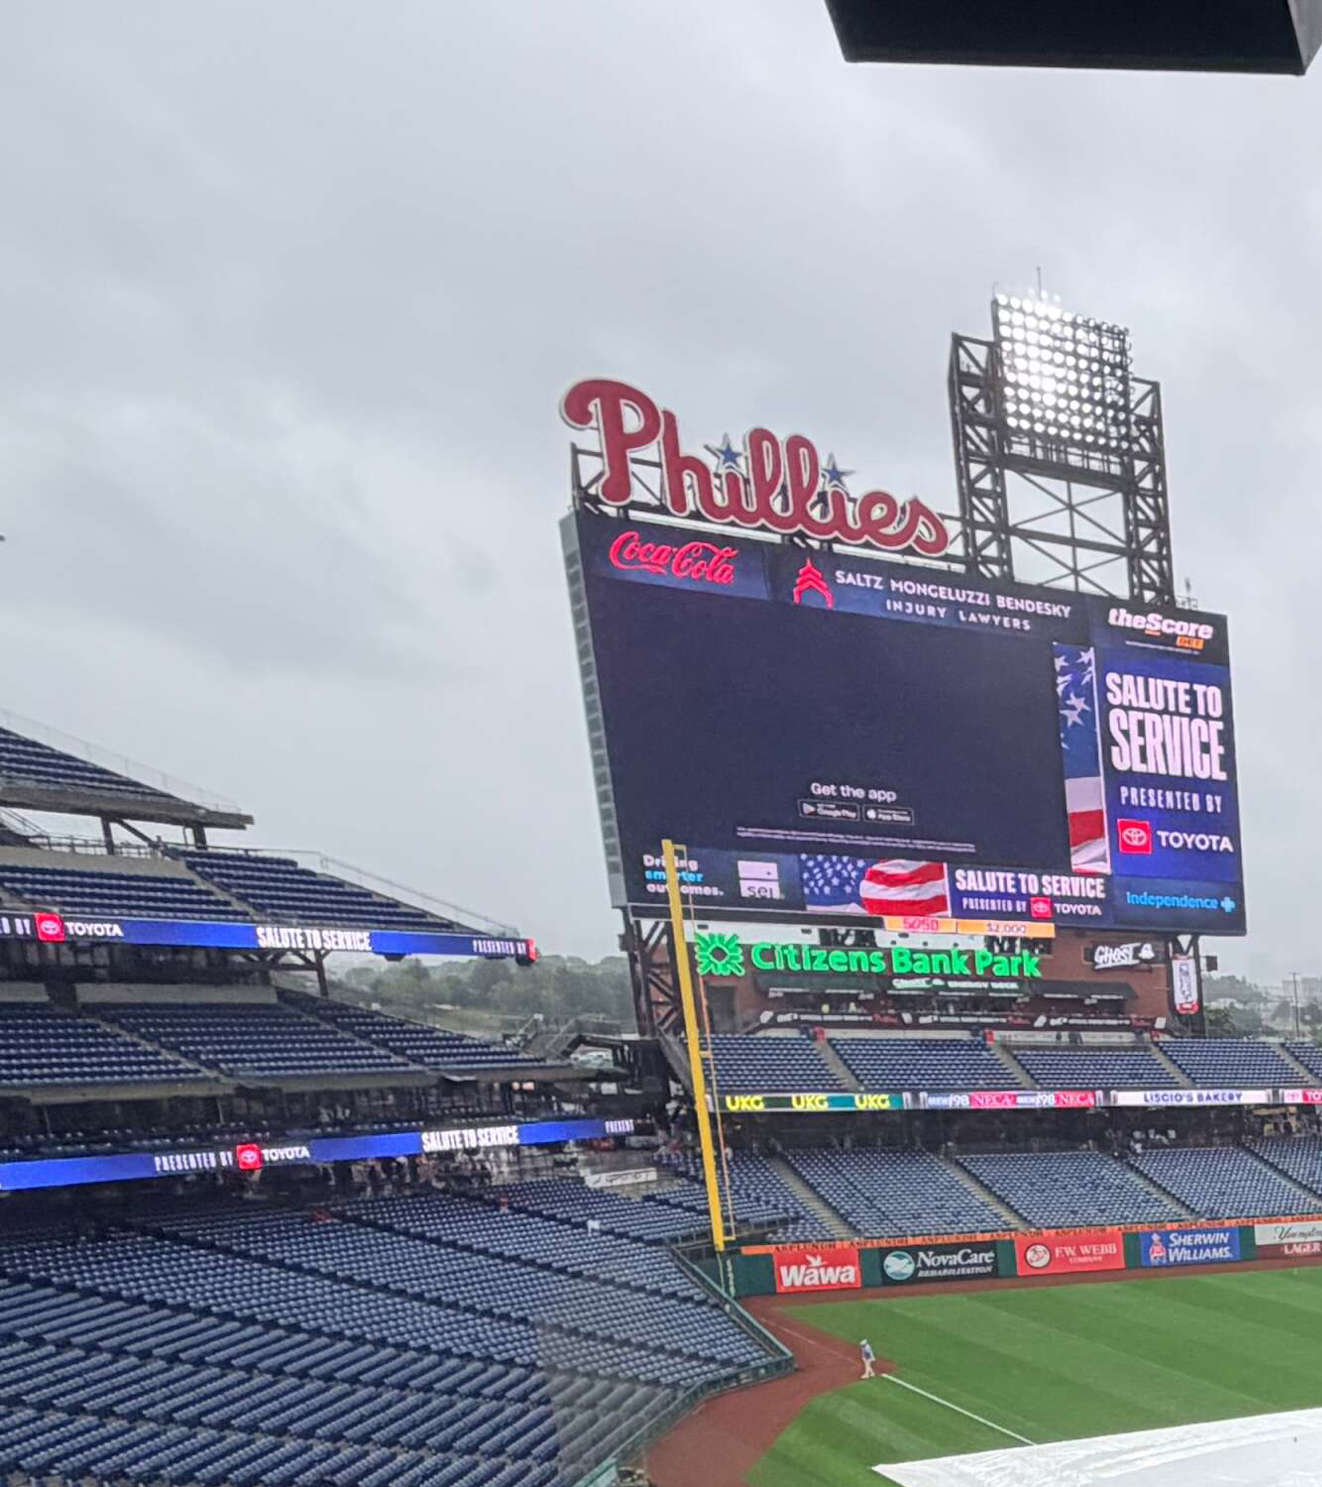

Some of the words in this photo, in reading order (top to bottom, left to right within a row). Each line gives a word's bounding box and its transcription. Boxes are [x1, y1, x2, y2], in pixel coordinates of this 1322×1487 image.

[560, 379, 950, 557] Phillies
[609, 531, 739, 585] Coca-Cola
[835, 570, 884, 591] SALTZ
[890, 578, 990, 606] MONGELUZZI
[996, 595, 1072, 618] BENDESKY
[886, 599, 946, 618] INJURY
[959, 611, 1031, 631] LAWYERS
[1108, 608, 1214, 639] theScore
[1105, 672, 1192, 713] SALUTE
[1193, 684, 1223, 717] TO
[1108, 710, 1228, 780] SERVICE
[811, 782, 837, 797] Get
[840, 784, 865, 798] the
[868, 788, 897, 803] app
[1120, 786, 1200, 811] PRESENTED
[1206, 795, 1222, 813] BY
[1157, 830, 1234, 852] TOYOTA
[643, 854, 699, 872] Driing
[955, 869, 1017, 893] SALUTE
[1018, 873, 1039, 894] TO
[1042, 875, 1106, 898] SERVICE
[962, 897, 1013, 912] PRESENTED
[1016, 901, 1027, 912] BY
[1054, 903, 1102, 915] TOYOTA
[65, 922, 124, 937] TOYOTA
[256, 927, 305, 949] SALUTE
[305, 929, 322, 950] TO
[322, 931, 373, 951] SERVICE
[752, 943, 886, 972] Citizens
[892, 947, 971, 975] Bank
[974, 948, 1042, 977] Park
[1094, 942, 1140, 967] GHOST
[727, 1094, 764, 1110] UKG
[791, 1094, 829, 1110] UKG
[854, 1094, 889, 1110] UKG
[1144, 1094, 1194, 1103] LISCIO'S
[1197, 1092, 1243, 1102] BAKERY
[421, 1131, 463, 1152] SALUTE
[463, 1129, 478, 1149] TO
[478, 1125, 519, 1147] SERVICE
[155, 1153, 217, 1171] PRESENTED
[220, 1151, 233, 1166] BY
[261, 1147, 310, 1162] TOYOTA
[1079, 1243, 1117, 1256] WEBB
[1169, 1232, 1230, 1247] SHERWIN
[1284, 1242, 1321, 1255] LAGER
[916, 1248, 995, 1268] NovaCare
[780, 1264, 856, 1287] Wawa
